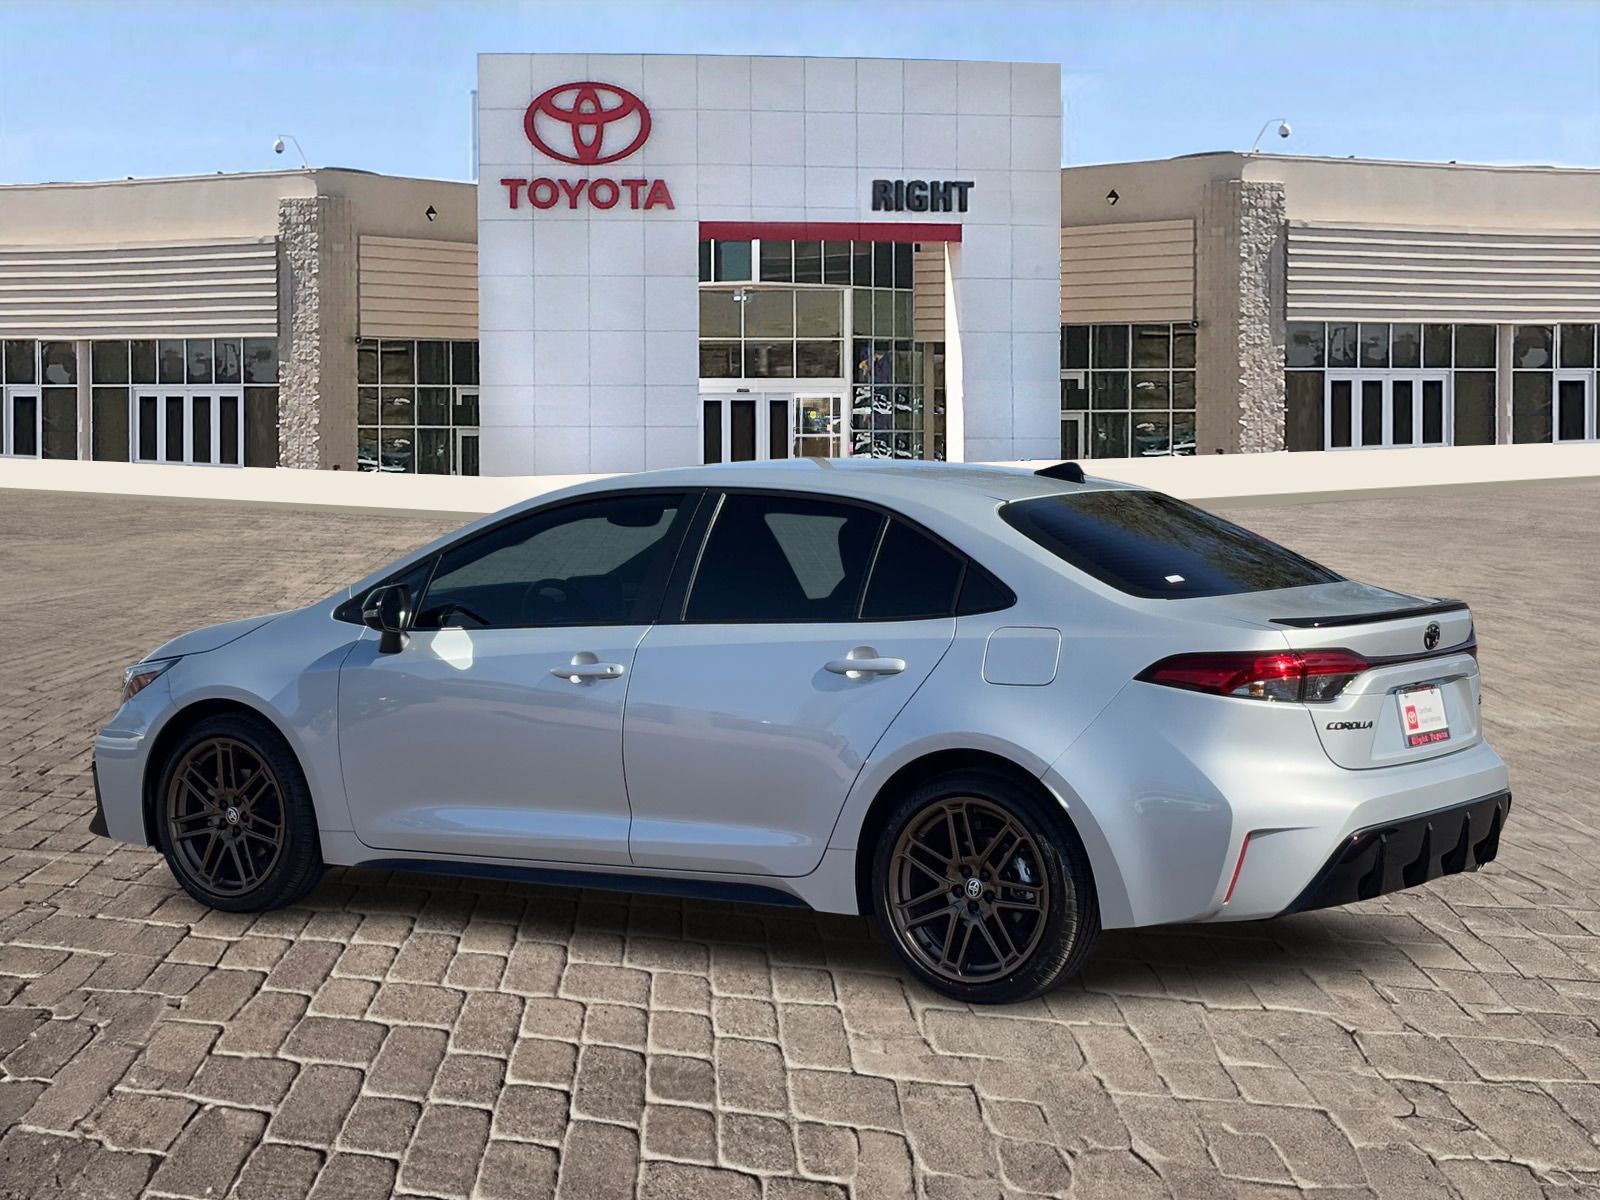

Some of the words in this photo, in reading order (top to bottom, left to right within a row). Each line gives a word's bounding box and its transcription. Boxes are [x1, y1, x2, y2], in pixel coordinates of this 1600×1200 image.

[500, 178, 676, 210] TOYOTA
[872, 179, 975, 212] RIGHT
[1326, 720, 1374, 730] COROLLA
